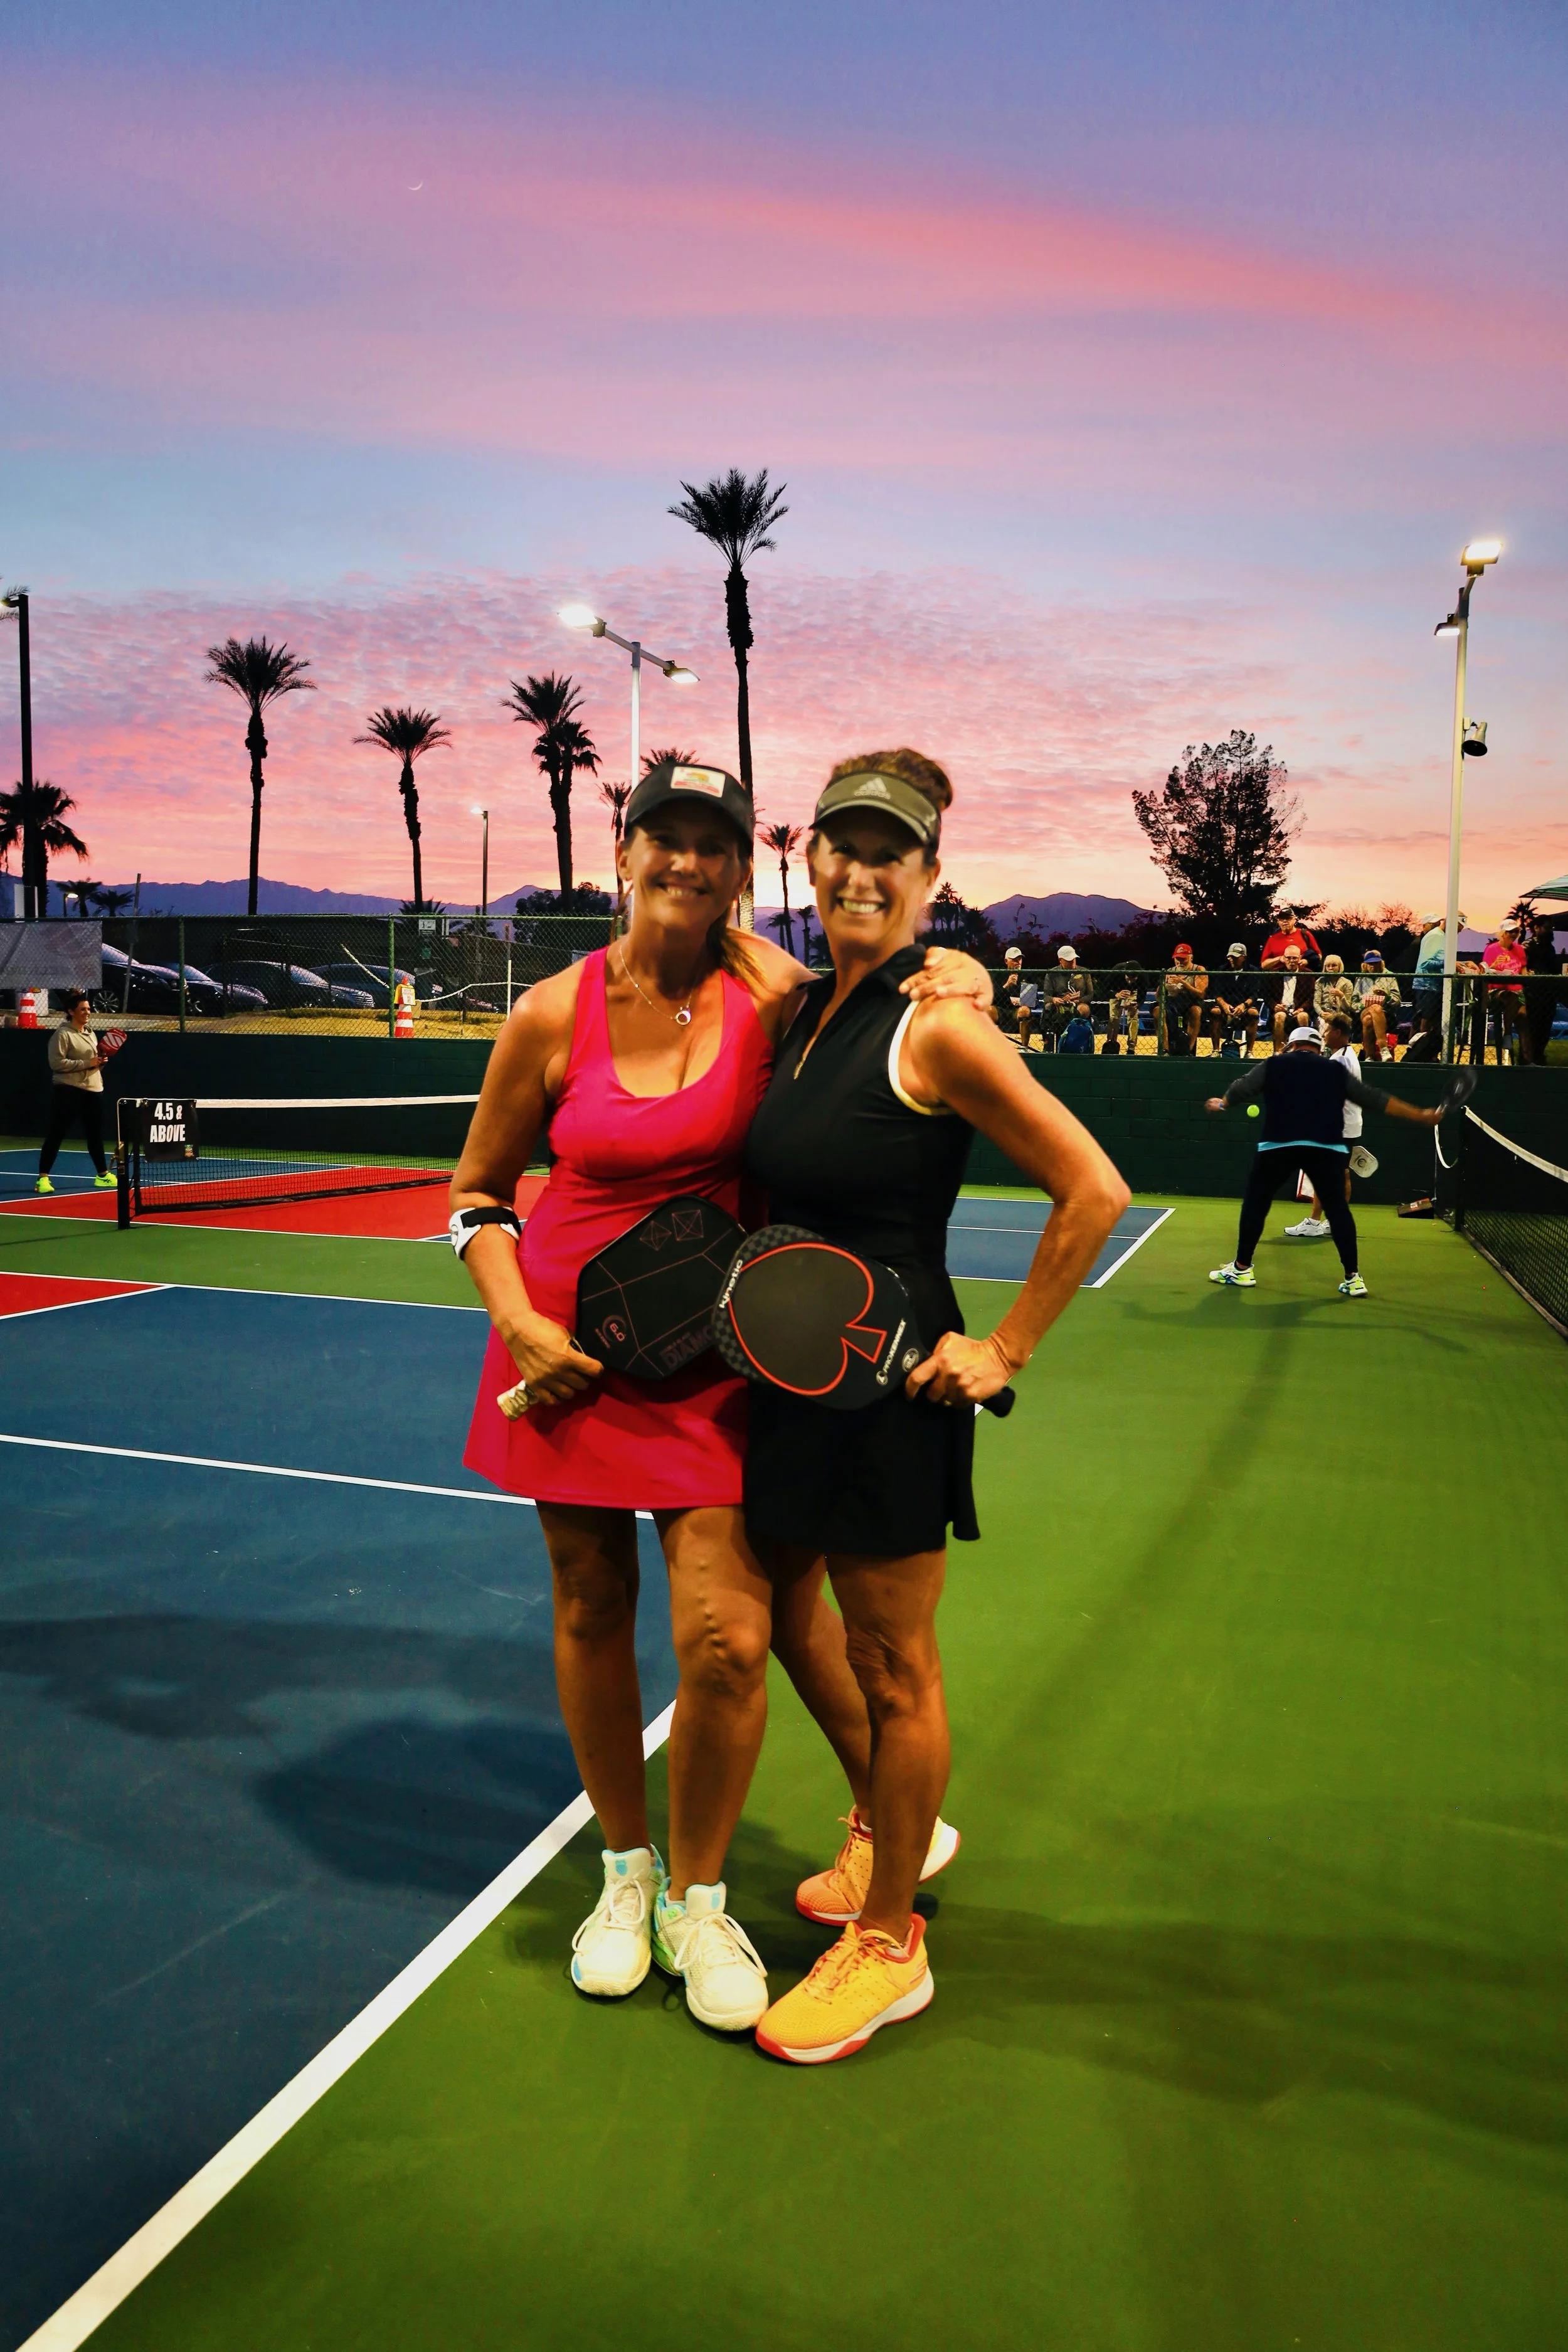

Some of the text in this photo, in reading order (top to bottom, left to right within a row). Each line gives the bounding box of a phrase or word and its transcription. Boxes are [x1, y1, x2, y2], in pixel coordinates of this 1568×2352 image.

[154, 1103, 183, 1120] 4.5 &
[150, 1124, 186, 1143] ABOVE
[661, 1325, 713, 1370] DIAMO
